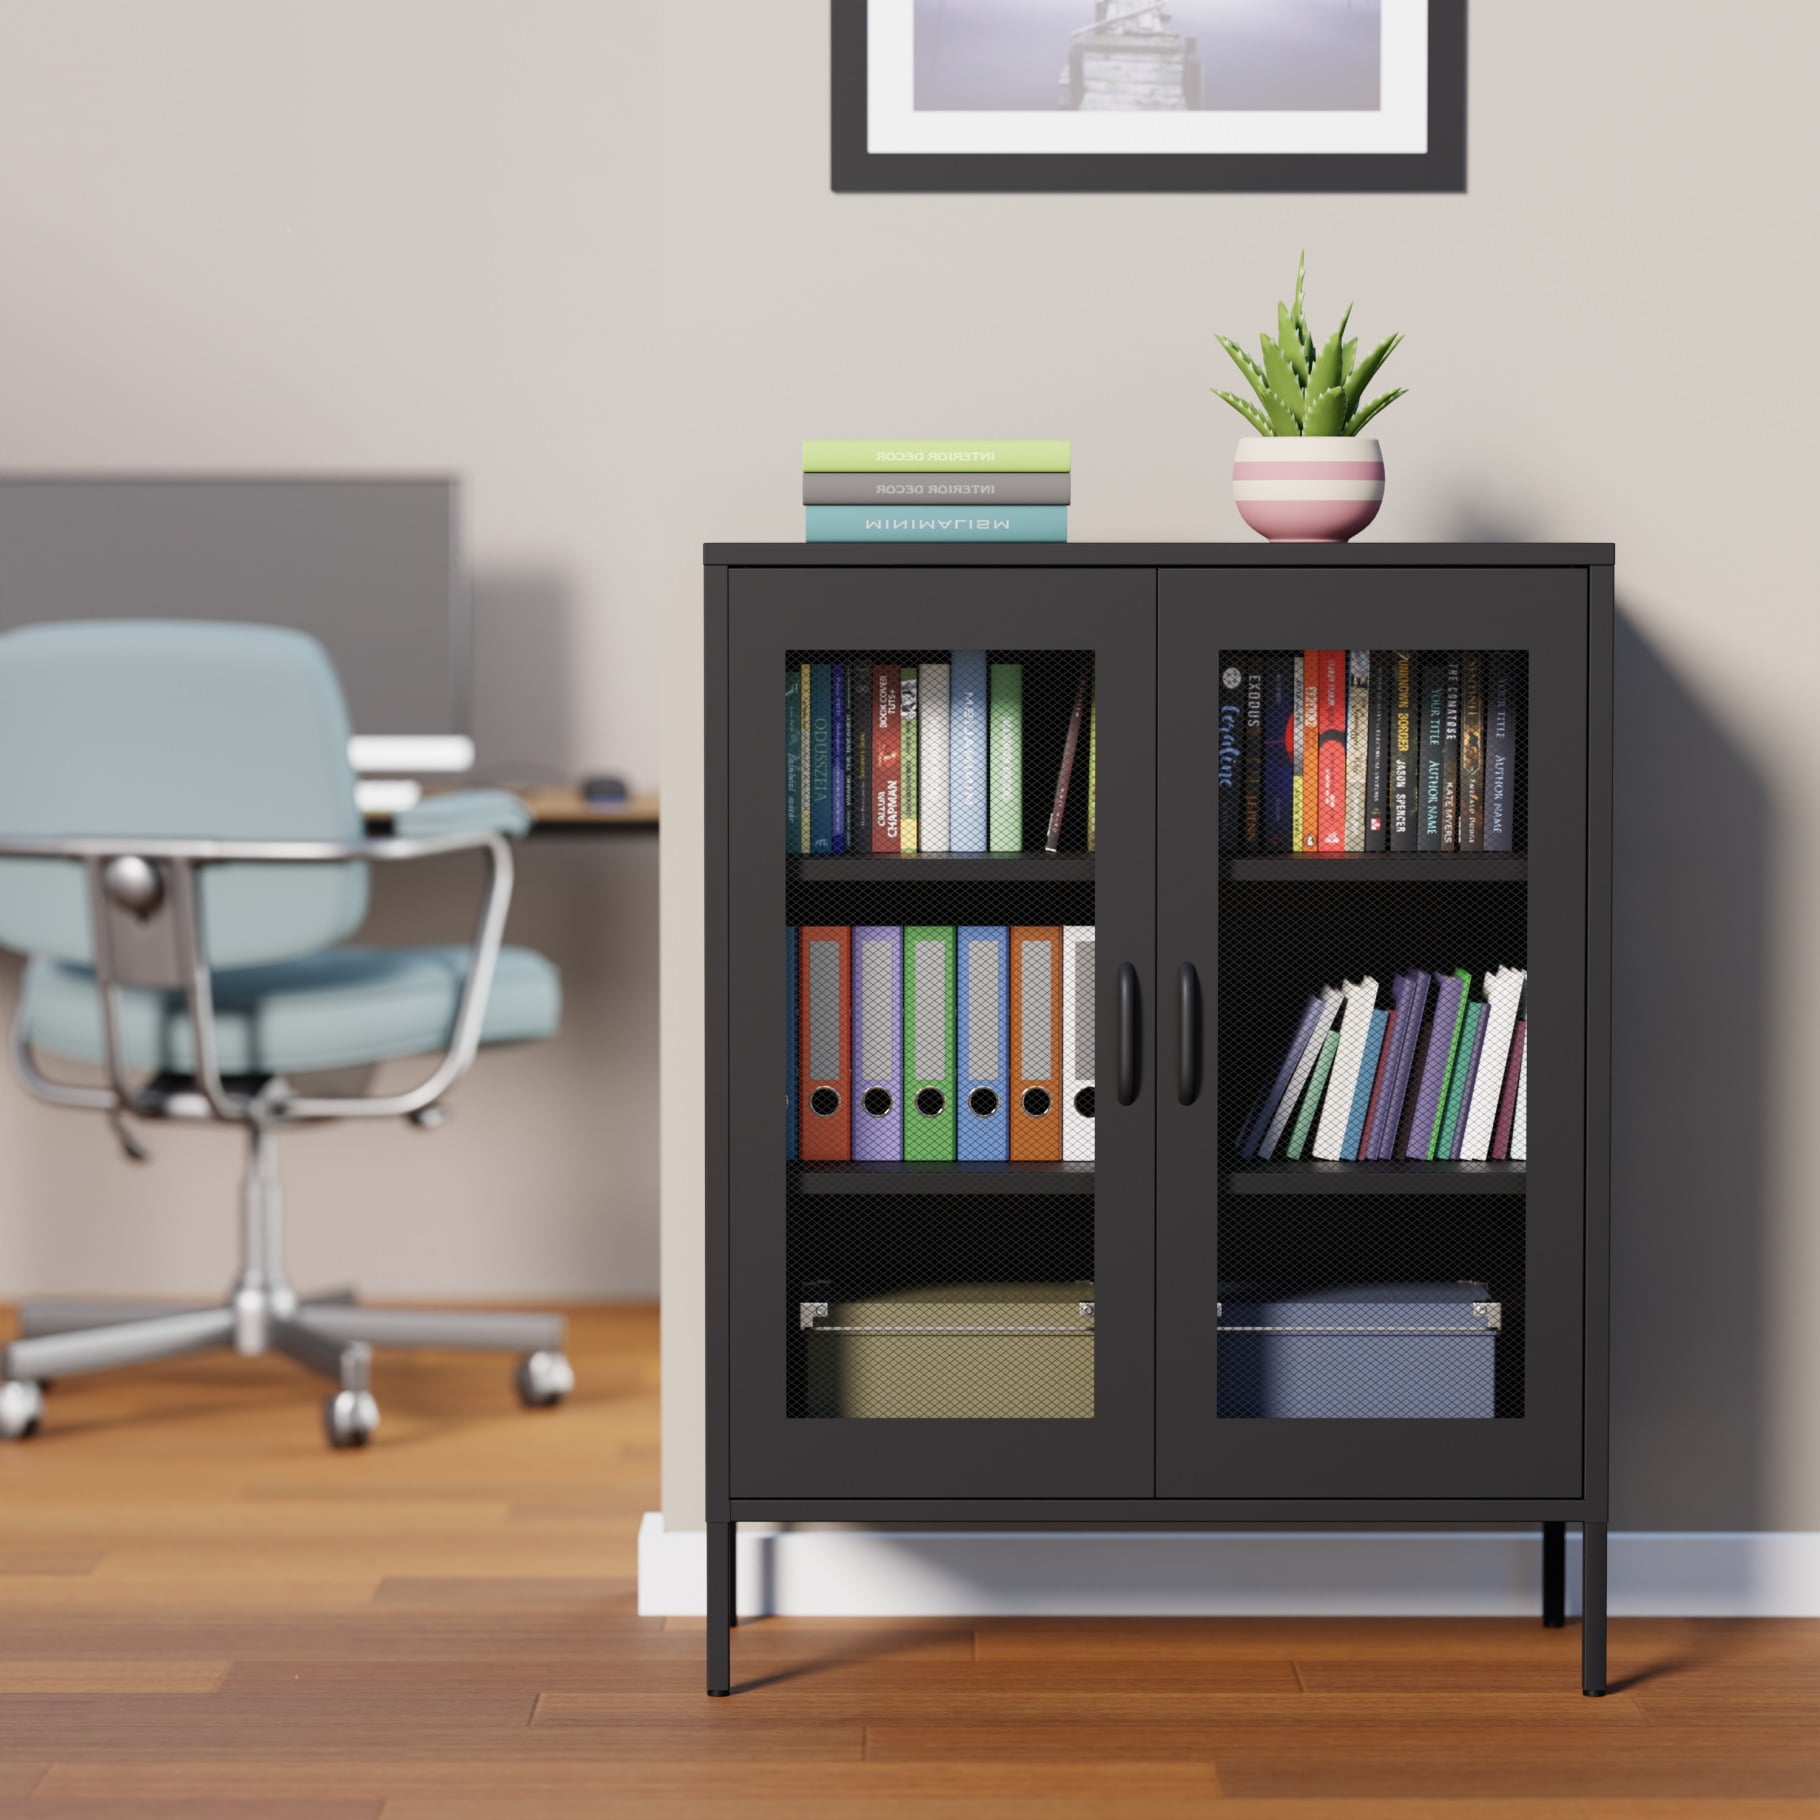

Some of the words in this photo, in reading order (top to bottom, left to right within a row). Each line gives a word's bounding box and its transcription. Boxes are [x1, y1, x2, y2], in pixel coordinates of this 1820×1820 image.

[1448, 664, 1458, 681] THE
[879, 675, 887, 703] COVER
[1248, 675, 1261, 727] EXODUS
[1430, 688, 1442, 716] YOUR
[1496, 678, 1507, 708] YOUR
[879, 705, 887, 728] BOOK
[1446, 686, 1457, 740] COMATOSE
[1496, 712, 1506, 738] TITLE
[1429, 720, 1440, 745] TITLE
[1396, 760, 1407, 787] JASON
[1427, 760, 1440, 803] AUTHOR
[1494, 755, 1506, 800] AUTHOR
[877, 792, 886, 826] CALLUM
[887, 781, 898, 838] CHAPMAN
[1445, 782, 1453, 807] KATE
[1396, 794, 1406, 832] SPENCER
[1427, 806, 1438, 835] NAME
[1444, 809, 1453, 843] MYERS
[1493, 803, 1503, 834] NAME
